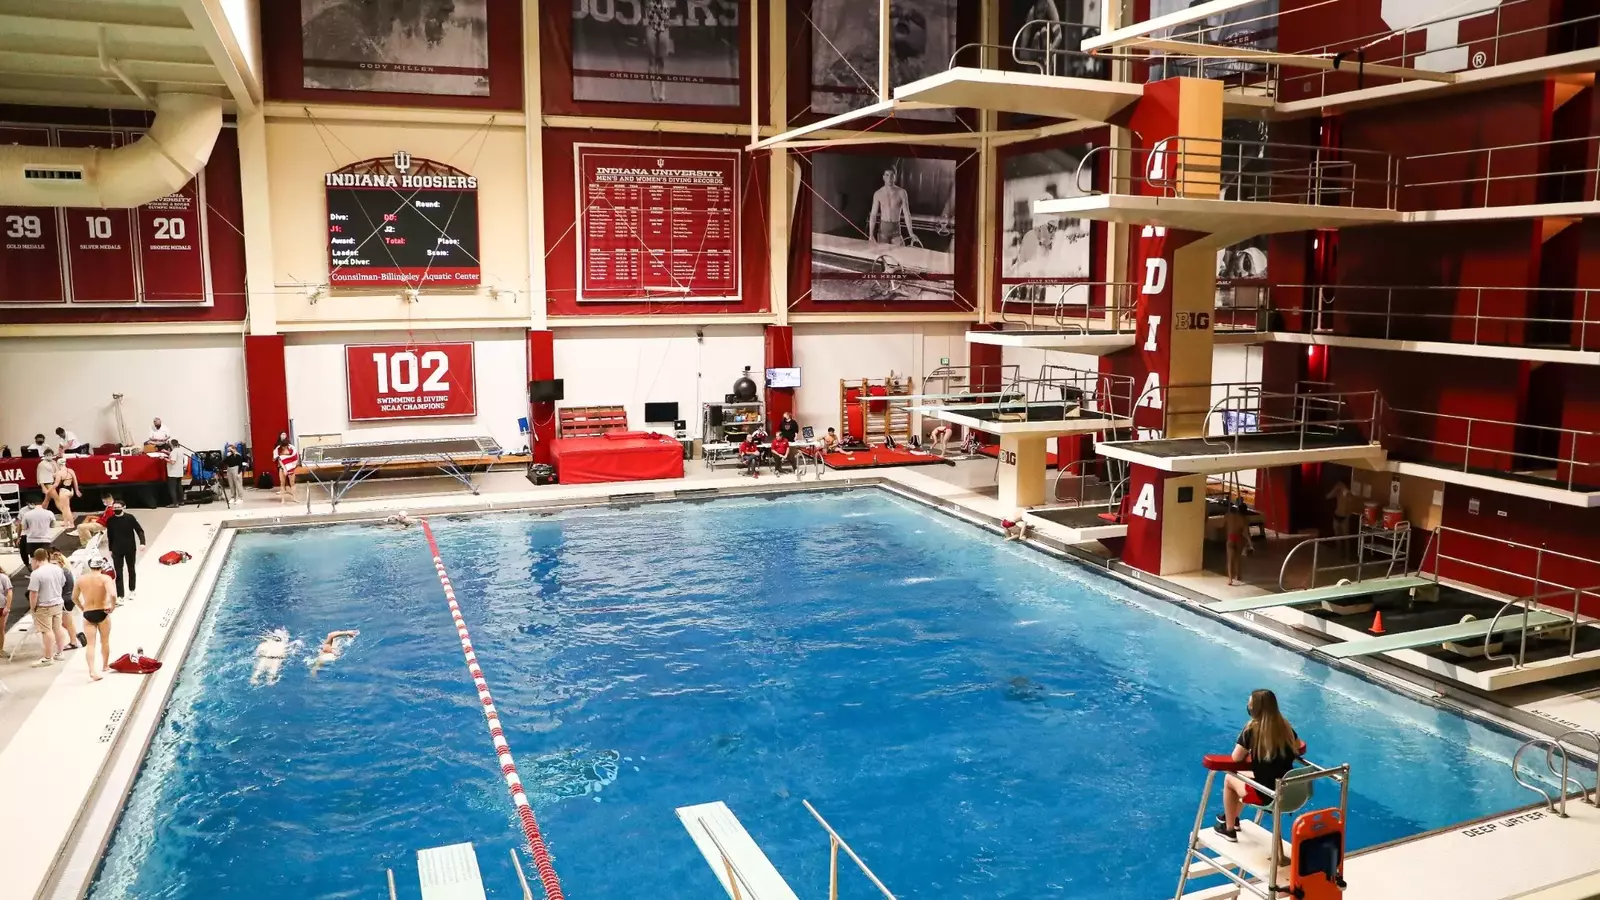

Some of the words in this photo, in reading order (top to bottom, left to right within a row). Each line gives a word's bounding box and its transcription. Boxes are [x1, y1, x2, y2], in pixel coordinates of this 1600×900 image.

[394, 64, 434, 72] MILLER
[609, 72, 662, 81] CHRISTINA
[596, 167, 649, 175] INDIANA
[651, 168, 723, 177] UNIVERSITY
[326, 173, 398, 187] INDIANA
[401, 174, 477, 189] HOOSIERS
[415, 200, 441, 208] Round:
[330, 213, 349, 221] Dive:
[5, 215, 42, 239] 39
[85, 216, 112, 239] 10
[153, 217, 186, 240] 20
[437, 237, 460, 245] Place:
[332, 249, 359, 257] Leader:
[427, 249, 449, 257] Score:
[332, 273, 420, 283] Counsilman-Billingsley
[424, 272, 452, 281] Aquatic
[454, 272, 480, 280] Center
[372, 350, 450, 394] 102
[376, 396, 416, 404] SWIMMING
[381, 404, 402, 412] NCAA
[403, 402, 445, 411] CHAMPIONS
[1461, 823, 1498, 838] DEEP
[1499, 811, 1548, 828] WATER
